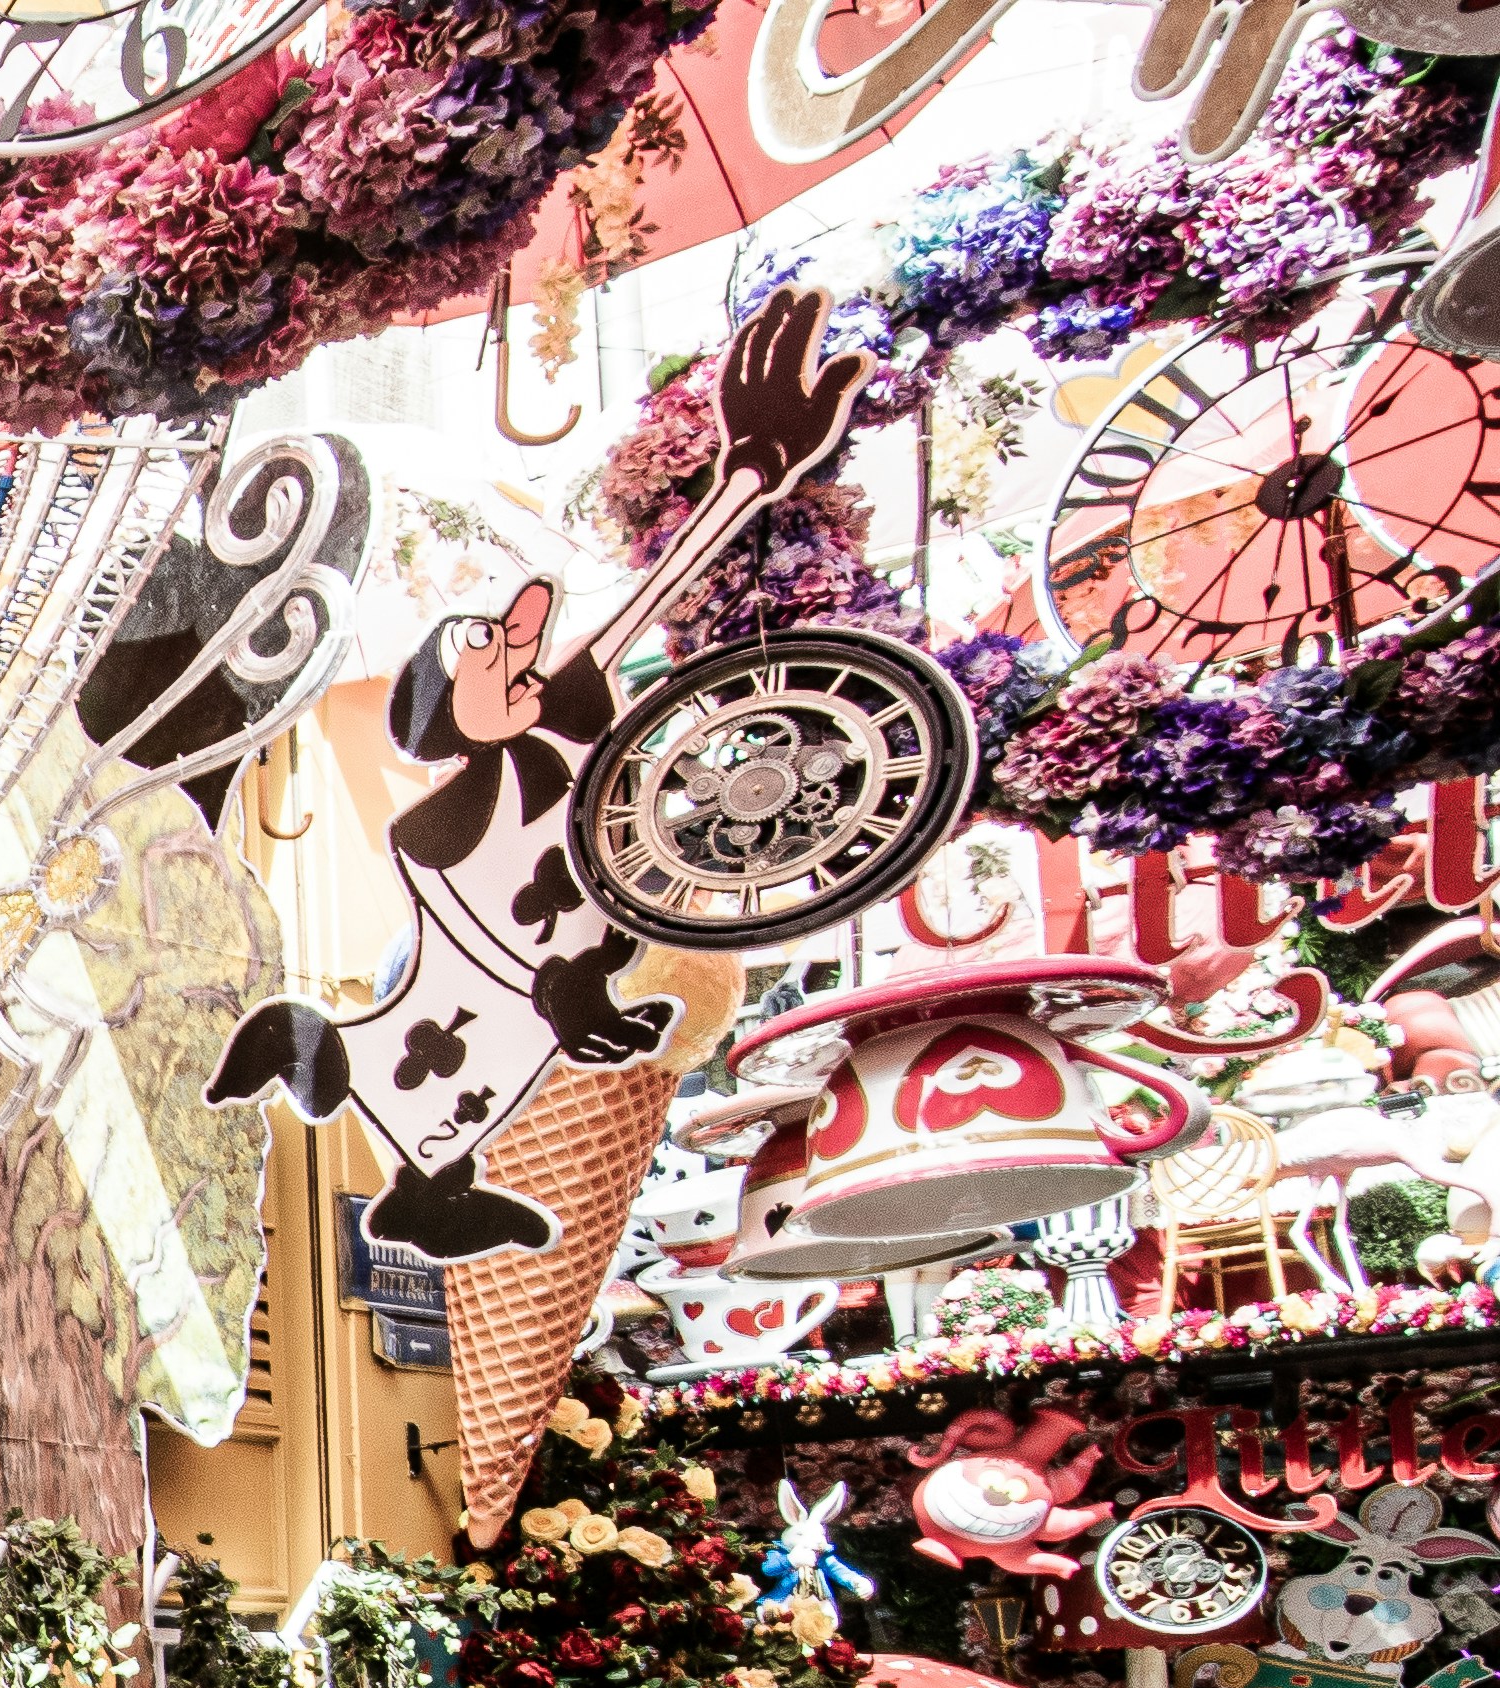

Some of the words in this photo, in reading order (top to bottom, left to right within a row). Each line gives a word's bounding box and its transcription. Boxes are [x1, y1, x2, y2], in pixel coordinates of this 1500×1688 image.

[0, 19, 80, 141] 7
[120, 0, 188, 105] 6
[1059, 444, 1157, 510] 10
[417, 1119, 461, 1159] 2
